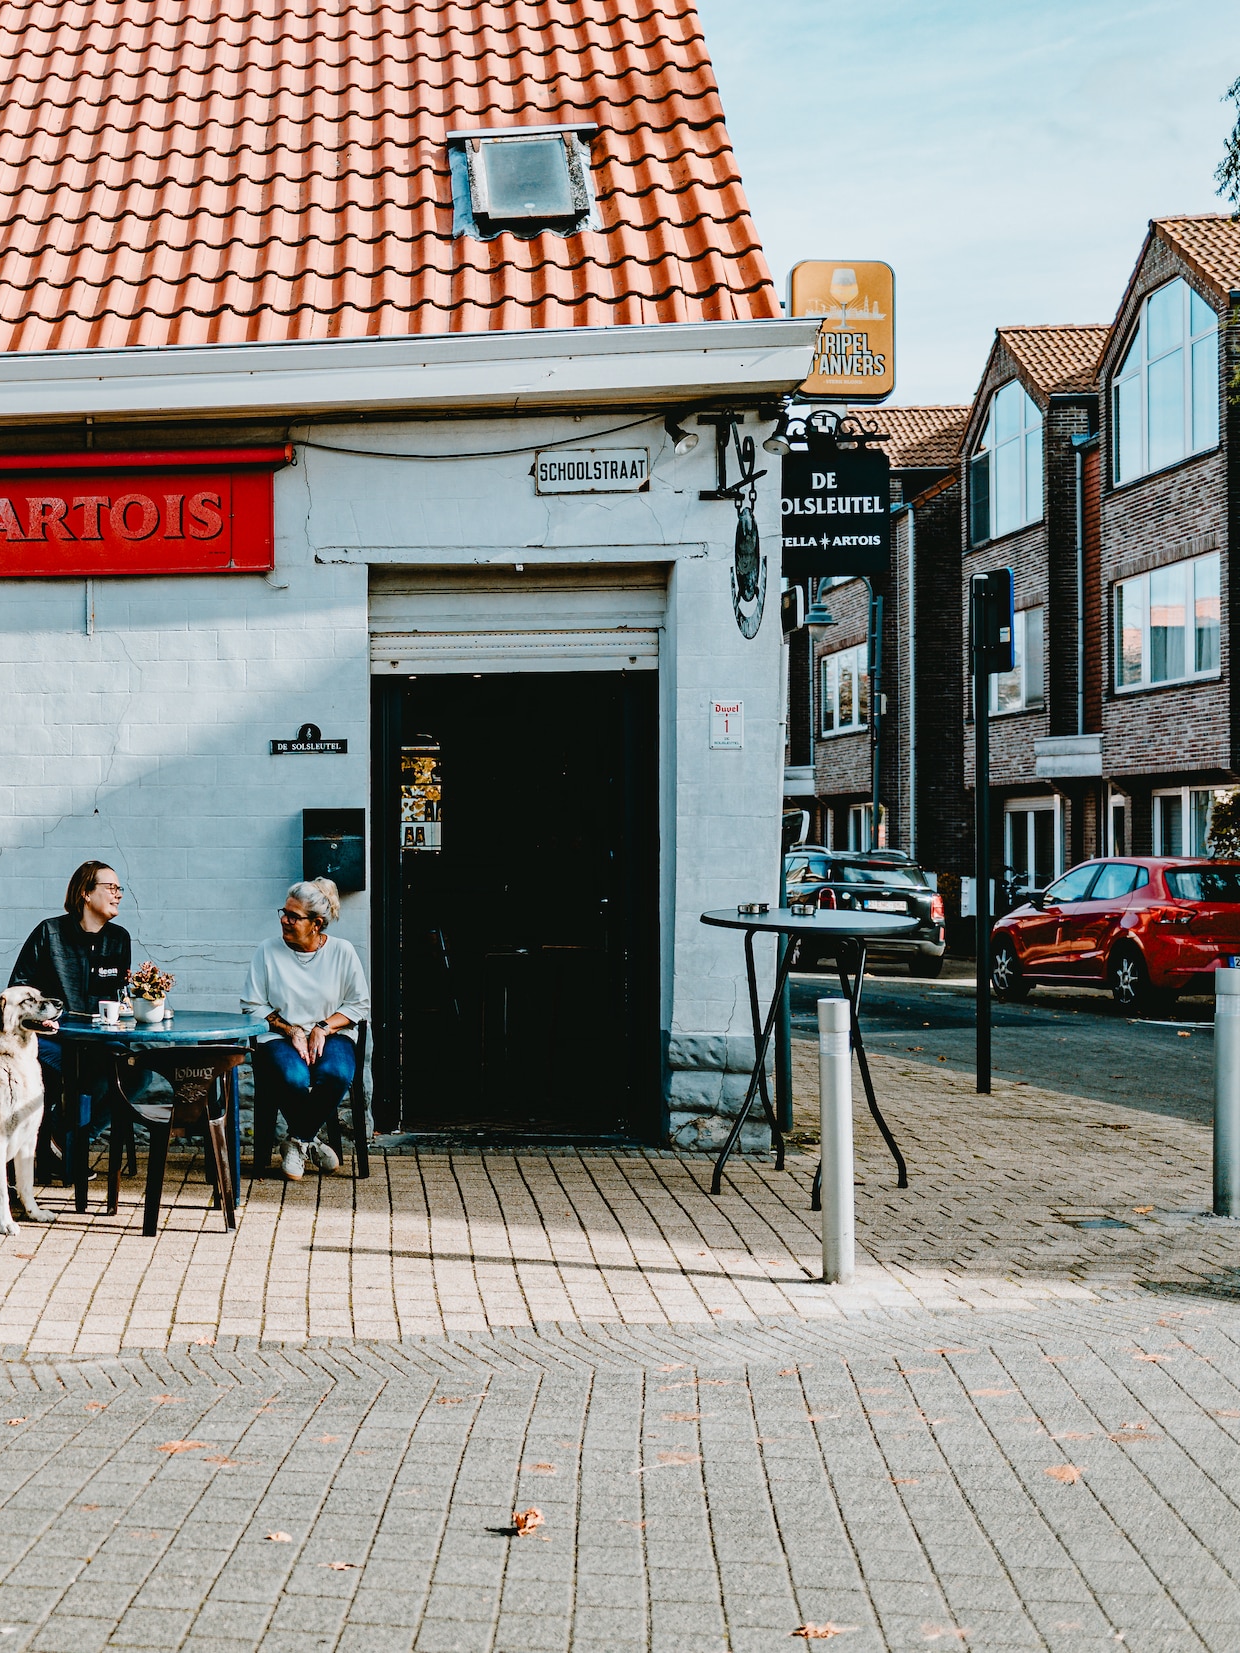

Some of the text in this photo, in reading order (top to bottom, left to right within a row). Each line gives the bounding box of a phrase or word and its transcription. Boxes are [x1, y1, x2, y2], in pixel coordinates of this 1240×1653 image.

[816, 332, 873, 355] TRIPEL
[808, 353, 886, 377] 'ANVERS
[540, 459, 646, 482] SCHOOLSTRAAT
[811, 471, 838, 490] DE
[781, 495, 885, 516] OLSLEUTEL
[781, 535, 882, 548] TELLA ARTOIS
[715, 704, 739, 713] Duvel
[277, 742, 341, 751] DE SOLSLEUTEL
[174, 1066, 215, 1082] Loburg
